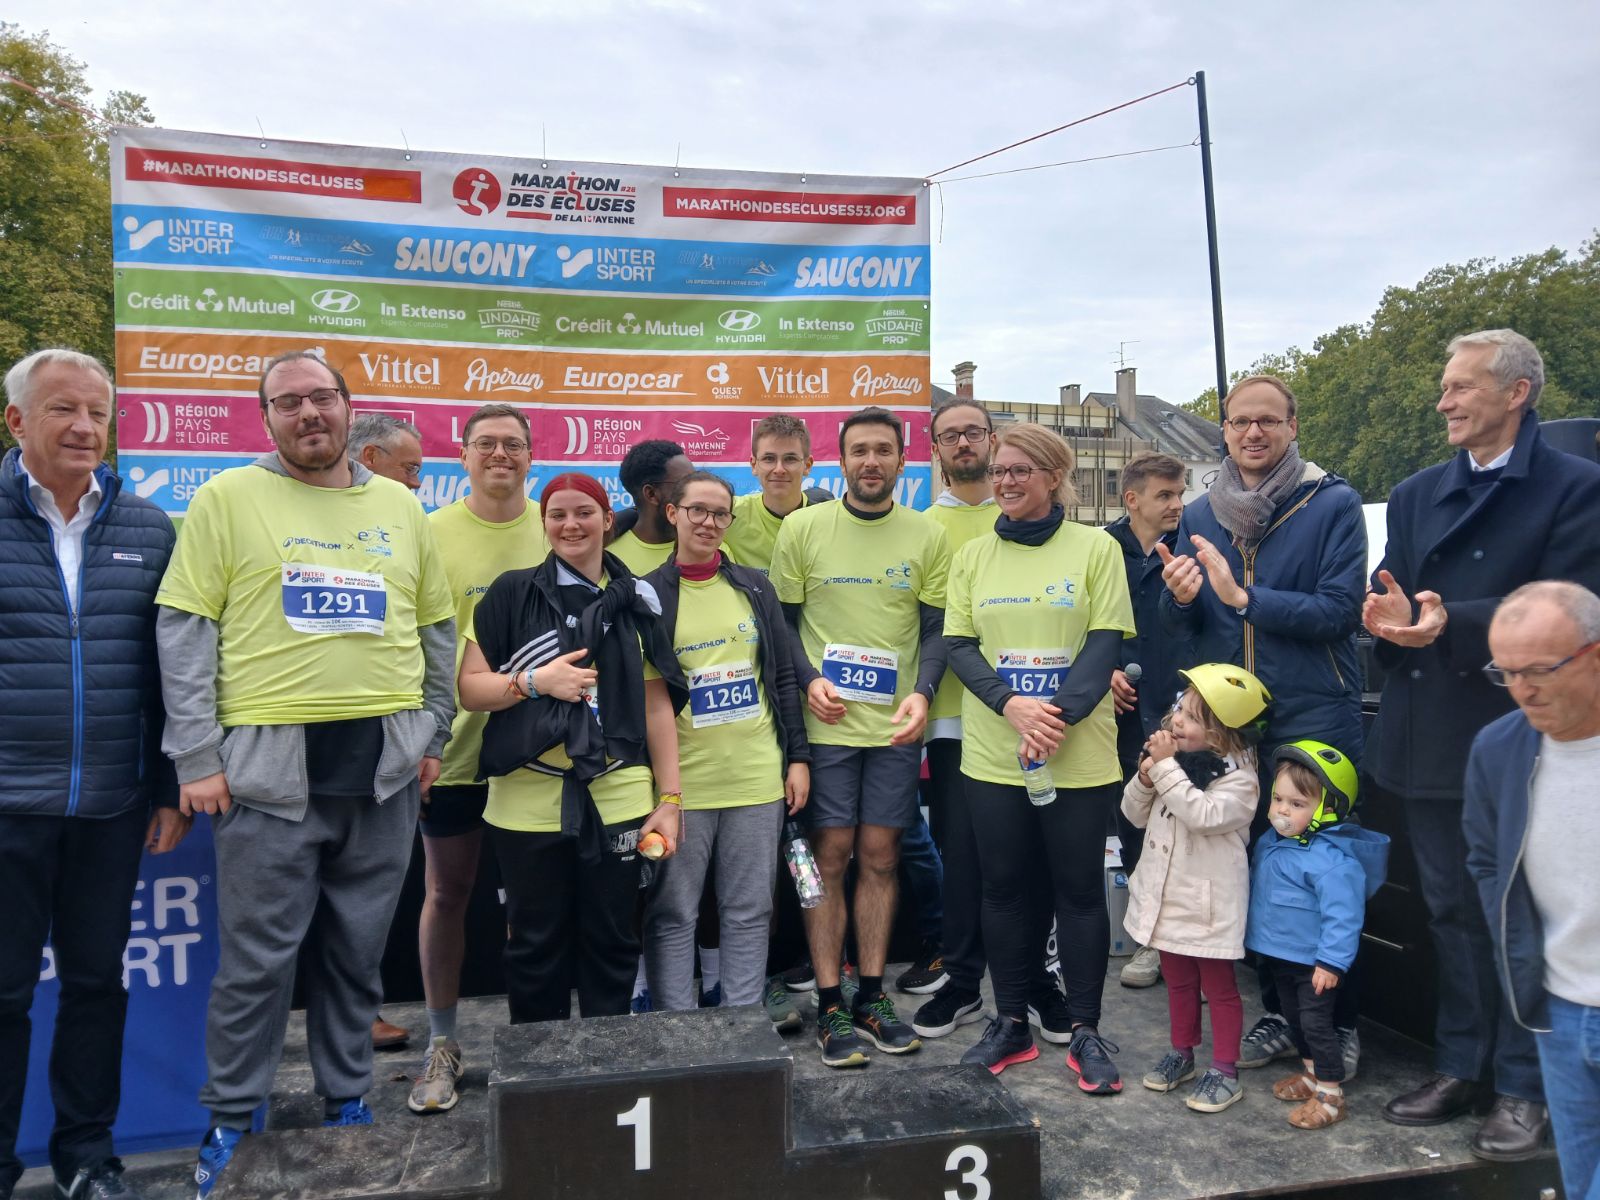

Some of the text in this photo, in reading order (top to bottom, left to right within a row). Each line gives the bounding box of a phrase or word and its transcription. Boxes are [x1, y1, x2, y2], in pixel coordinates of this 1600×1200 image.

[143, 159, 364, 191] #MARATHONDESECLUSES
[511, 172, 620, 191] MARATHON
[507, 193, 545, 208] DES
[676, 198, 906, 217] MARATHONDESECLUSES53.ORG
[168, 218, 233, 238] INTER
[584, 215, 635, 224] MAYENNE
[168, 237, 233, 254] SPORT
[394, 237, 536, 278] SAUCONY
[597, 248, 655, 265] INTER
[597, 266, 655, 281] SPORT
[794, 256, 921, 288] SAUCONY
[127, 292, 295, 315] Crédit Mutuel
[381, 303, 466, 320] In Extenso
[309, 315, 366, 327] HYUNDAI
[556, 316, 704, 337] Crédit Mutuel
[779, 318, 855, 331] In Extenso
[716, 334, 765, 343] HYUNDAI
[358, 353, 441, 385] Vittel
[463, 357, 544, 392] Apirun
[563, 366, 683, 394] Europcar
[756, 366, 829, 394] Vittel
[850, 364, 922, 398] Apirun
[711, 387, 742, 395] OUEST
[175, 403, 228, 418] RÉGION
[175, 418, 211, 431] PAYS
[594, 418, 642, 431] RÉGION
[188, 432, 229, 445] LOIRE
[594, 431, 626, 442] PAYS
[294, 537, 341, 550] DECATHLON
[301, 592, 369, 614] 1291
[685, 638, 726, 652] DECATHLON
[840, 667, 877, 688] 349
[1009, 673, 1060, 693] 1674
[705, 684, 752, 709] 1264
[616, 1097, 650, 1171] 1
[944, 1144, 991, 1200] 3
